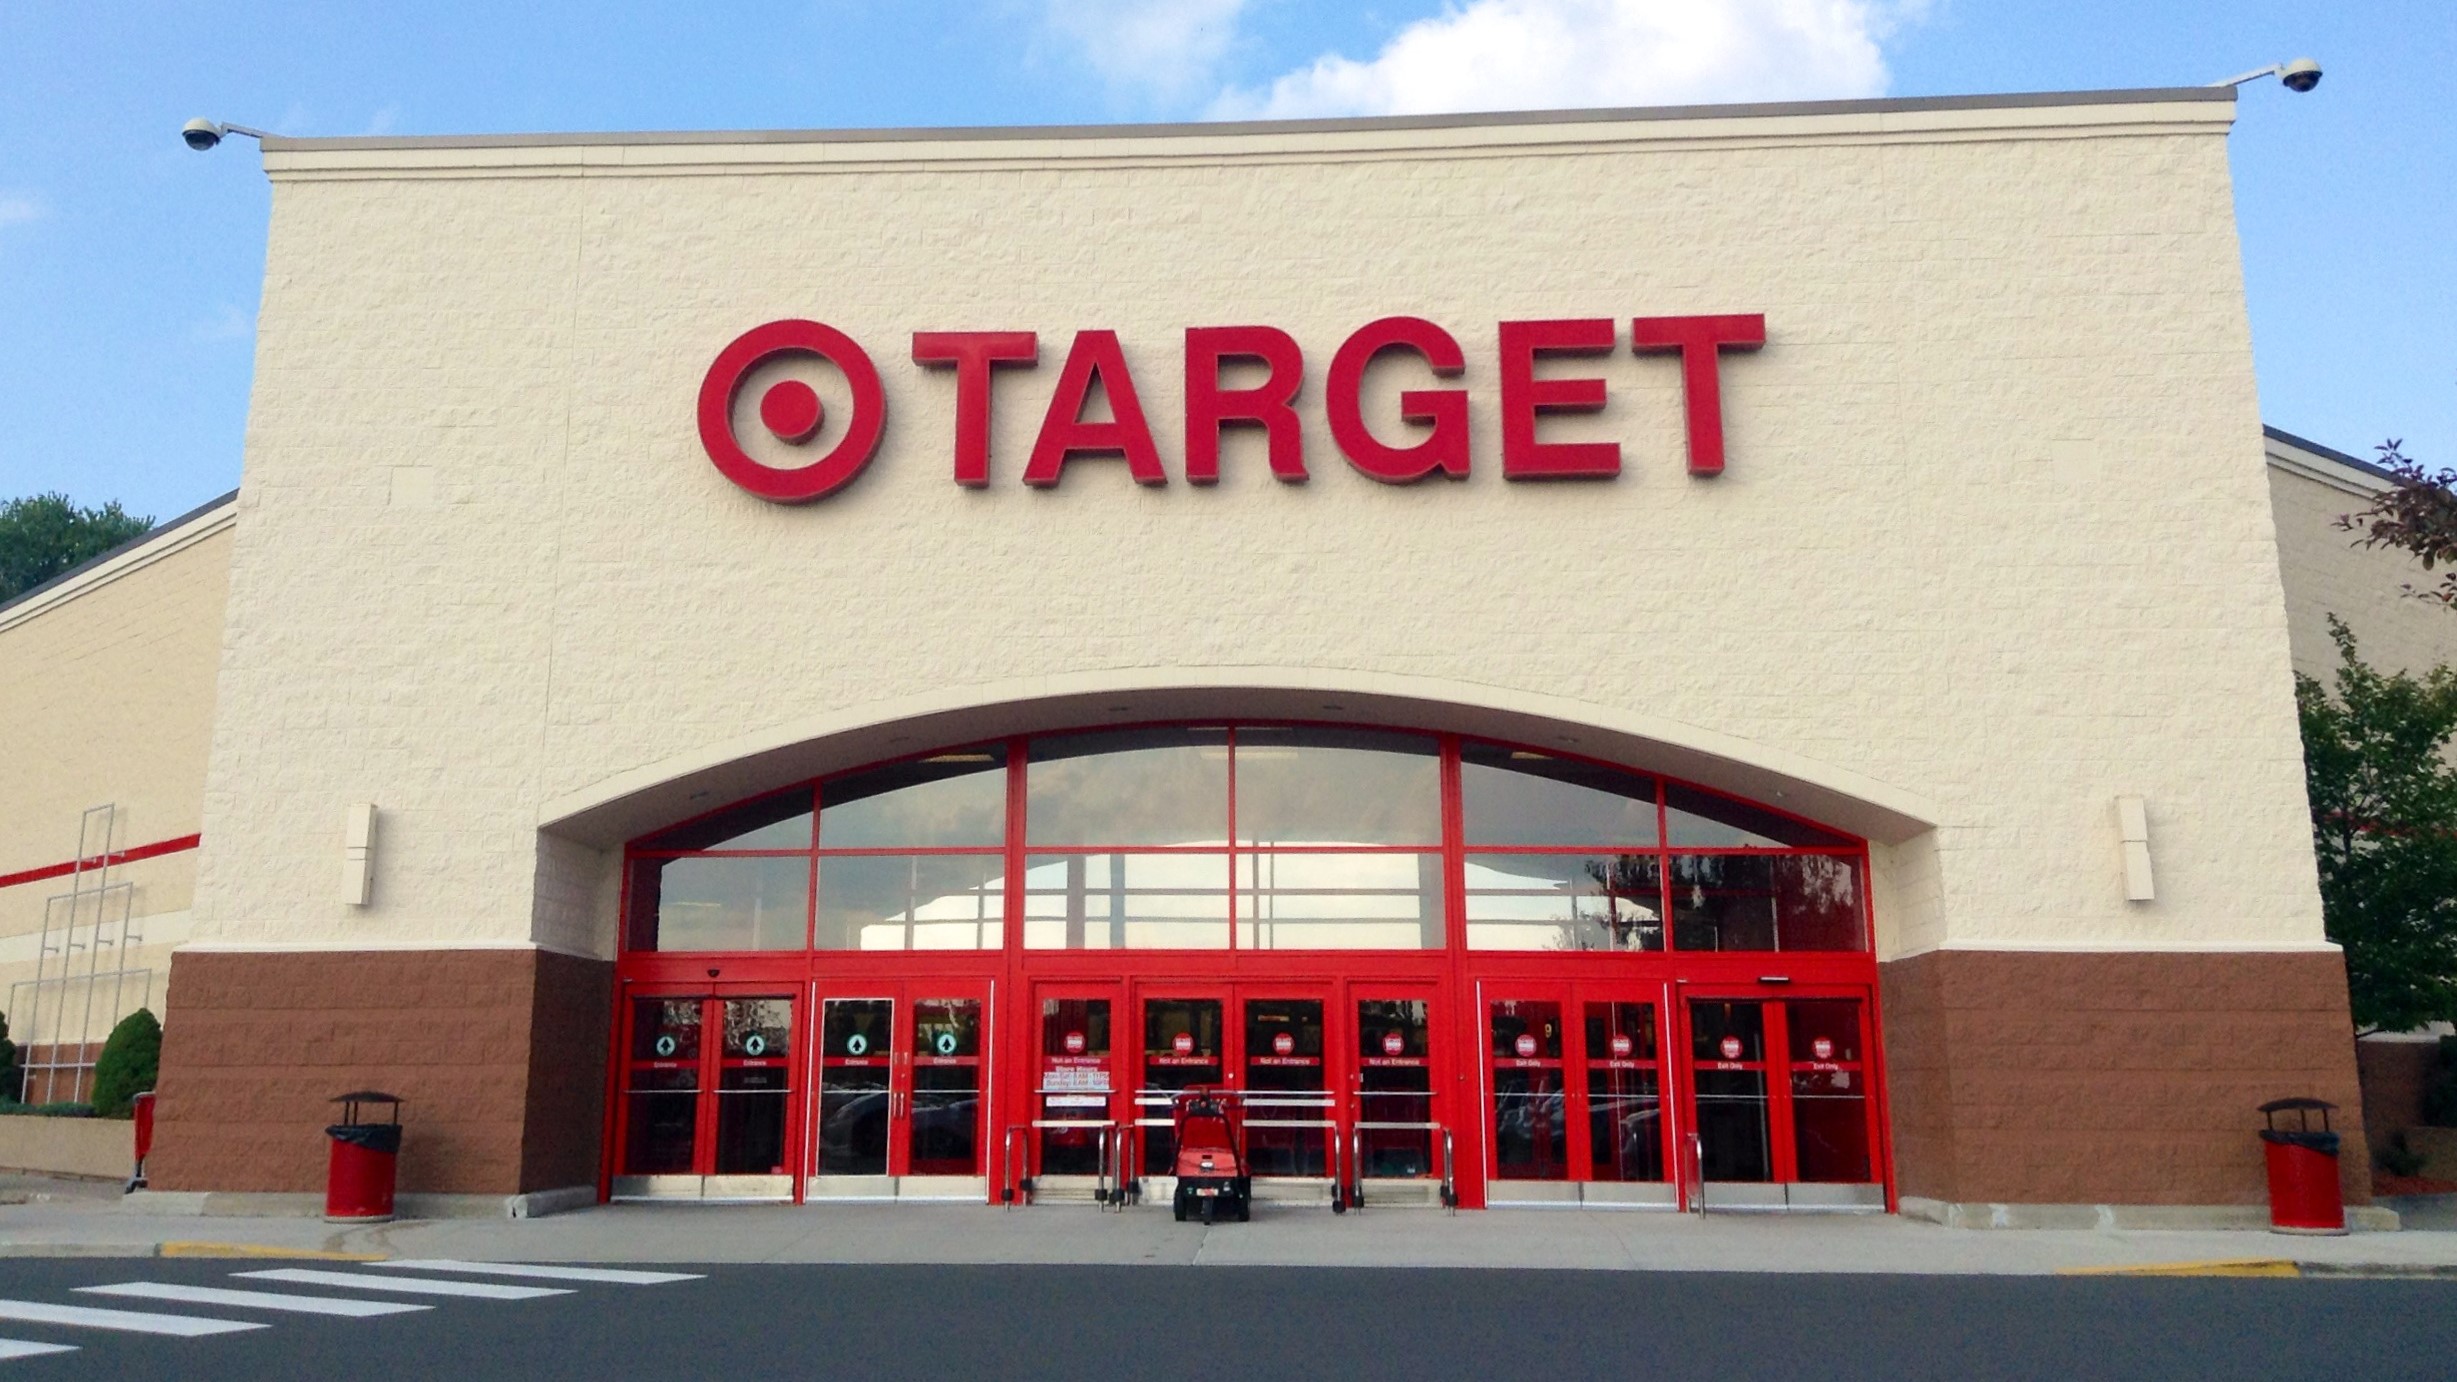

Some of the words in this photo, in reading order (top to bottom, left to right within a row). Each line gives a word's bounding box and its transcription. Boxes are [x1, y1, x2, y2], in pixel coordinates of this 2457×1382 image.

[911, 313, 1767, 488] TARGET
[1051, 1056, 1063, 1064] Not
[1064, 1056, 1073, 1064] an
[1073, 1056, 1101, 1064] Entrance
[1159, 1057, 1170, 1065] Not
[1170, 1057, 1180, 1065] an
[1181, 1057, 1209, 1065] Entrance
[1260, 1057, 1271, 1065] Not
[1272, 1057, 1281, 1065] an
[1282, 1057, 1310, 1065] Entrance
[1369, 1058, 1381, 1066] Not
[1381, 1058, 1390, 1066] an
[1391, 1058, 1420, 1066] Entrance
[1528, 1060, 1541, 1068] Only
[1622, 1061, 1634, 1069] Only
[1718, 1062, 1729, 1070] Exit
[1730, 1062, 1743, 1070] Only
